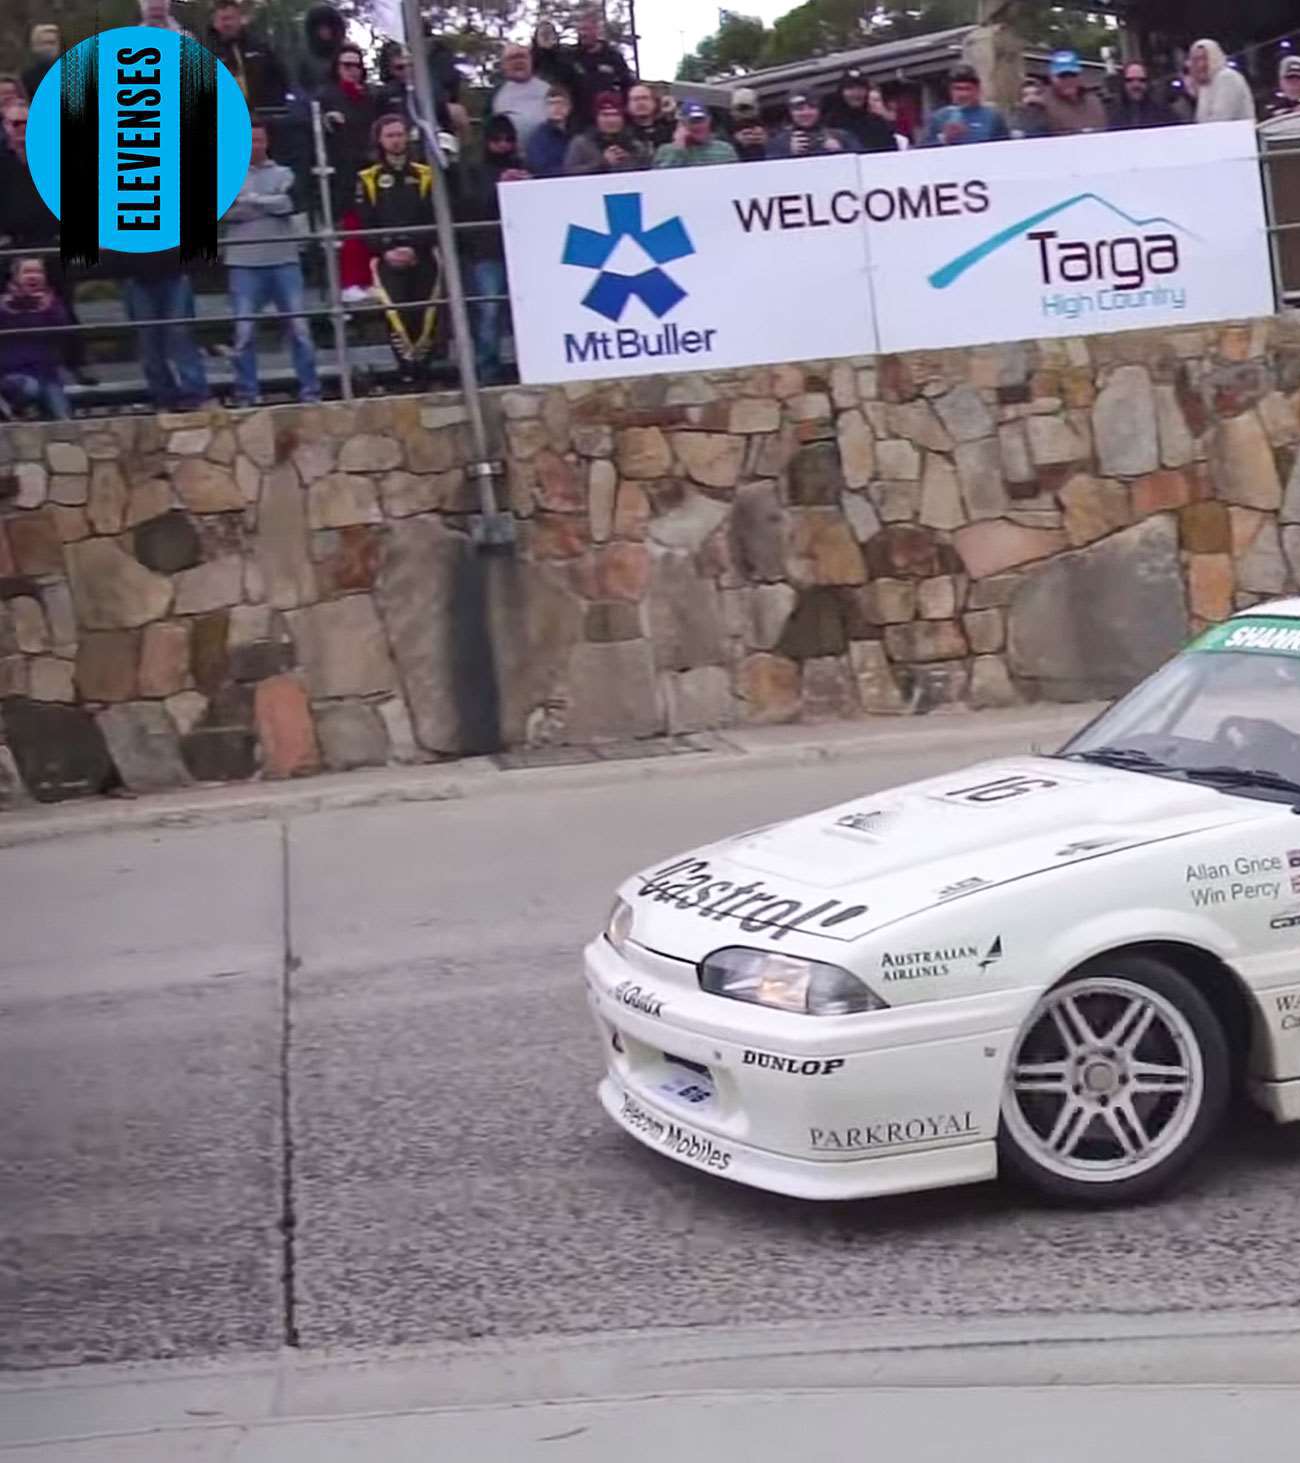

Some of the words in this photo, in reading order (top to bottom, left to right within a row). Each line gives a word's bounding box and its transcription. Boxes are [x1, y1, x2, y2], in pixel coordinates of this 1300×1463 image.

[734, 180, 990, 232] WELCOMES
[1027, 231, 1179, 290] Targa
[1042, 291, 1093, 318] High
[1099, 286, 1186, 311] Country
[564, 332, 614, 363] Mt
[616, 323, 717, 359] Buller
[1186, 863, 1230, 883] Allan
[638, 857, 842, 941] Castrol
[1192, 887, 1227, 907] Win
[1230, 882, 1281, 900] Percy
[881, 946, 978, 968] AUSTRALIAN
[882, 964, 949, 981] AIRLINES
[741, 1049, 846, 1076] DUNLOP
[664, 1122, 733, 1170] Mobiles
[809, 1111, 980, 1149] PARKROYAL
